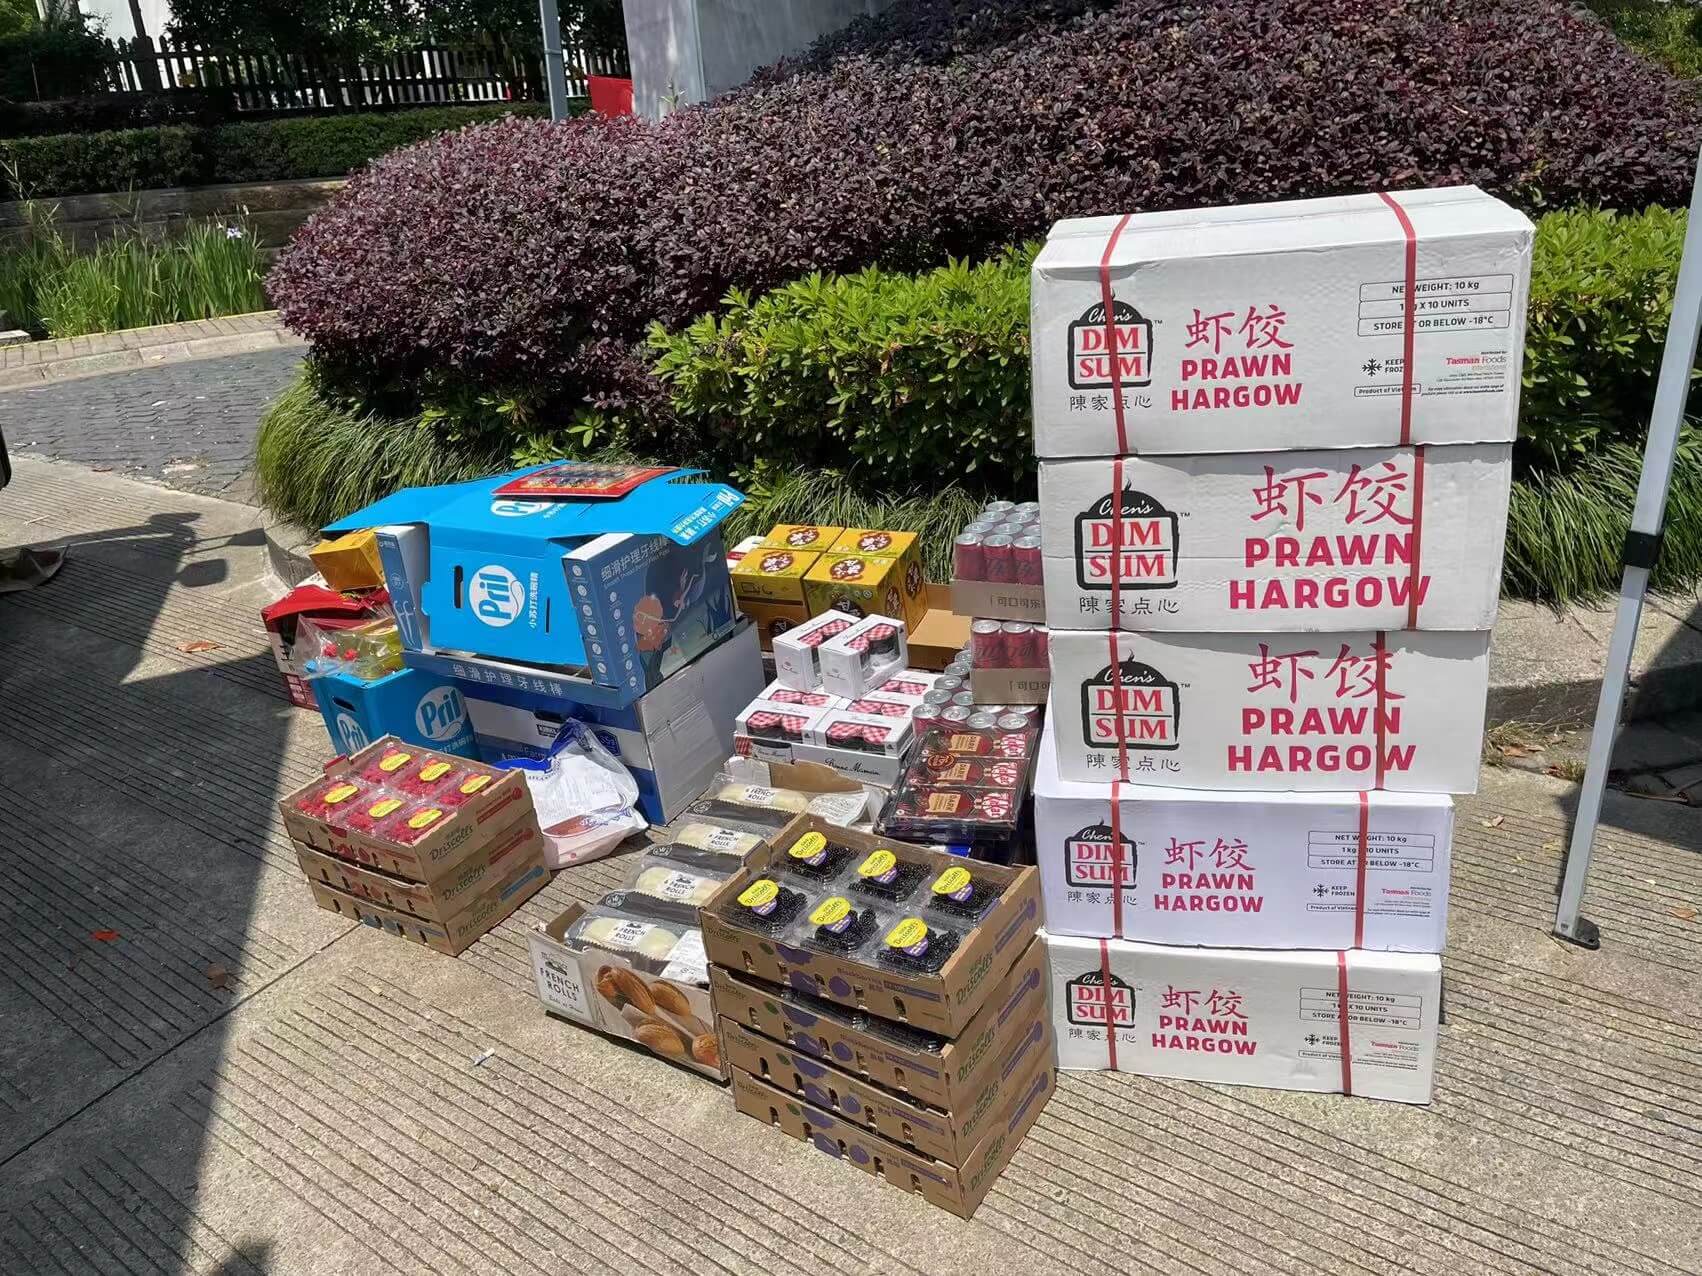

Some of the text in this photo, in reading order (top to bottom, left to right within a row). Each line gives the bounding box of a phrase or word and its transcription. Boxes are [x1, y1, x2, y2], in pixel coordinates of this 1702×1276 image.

[1392, 284, 1408, 294] NE
[1455, 282, 1466, 290] 10
[1467, 281, 1480, 290] kg
[1428, 301, 1439, 309] 10
[1440, 299, 1470, 309] UNITS
[1089, 308, 1133, 323] Chn's
[1373, 321, 1403, 331] STORE
[1418, 319, 1431, 328] OR
[1433, 317, 1467, 327] BELOW
[1185, 303, 1295, 354] 虾饺
[1079, 356, 1143, 378] SUM
[1181, 352, 1292, 381] PRAWN
[1445, 356, 1480, 365] Tasman
[1171, 382, 1303, 411] HARGOW
[1358, 387, 1383, 395] Product
[1099, 498, 1154, 515] Cen's
[1250, 462, 1415, 533] 虾饺
[1090, 520, 1163, 547] DIM
[1244, 533, 1412, 569] PRAWN
[1089, 554, 1166, 577] SUM
[479, 572, 512, 620] Pril
[1229, 575, 1431, 610] HARGOW
[1247, 641, 1406, 704] 虾饺
[1096, 688, 1163, 712] DIM
[420, 688, 461, 737] Pril
[1242, 706, 1401, 735] PRAWN
[1095, 717, 1168, 740] SUM
[1227, 744, 1417, 772] HARGOW
[1387, 835, 1396, 843] 10
[1076, 843, 1126, 861] DIM
[1164, 837, 1256, 872] 虾饺
[1375, 847, 1400, 855] UNITS
[1075, 864, 1129, 881] SUM
[1162, 872, 1254, 891] PRAWN
[1154, 893, 1264, 913] HARGOW
[620, 927, 646, 936] FRENCH
[540, 967, 580, 993] FRENCH
[546, 980, 577, 1002] ROLLS
[1078, 986, 1125, 1004] DIM
[1161, 984, 1249, 1020] 虾饺
[1076, 1005, 1128, 1021] SUM
[1359, 1015, 1386, 1024] BELOW
[1159, 1015, 1248, 1036] PRAWN
[1152, 1033, 1257, 1055] HARGOW
